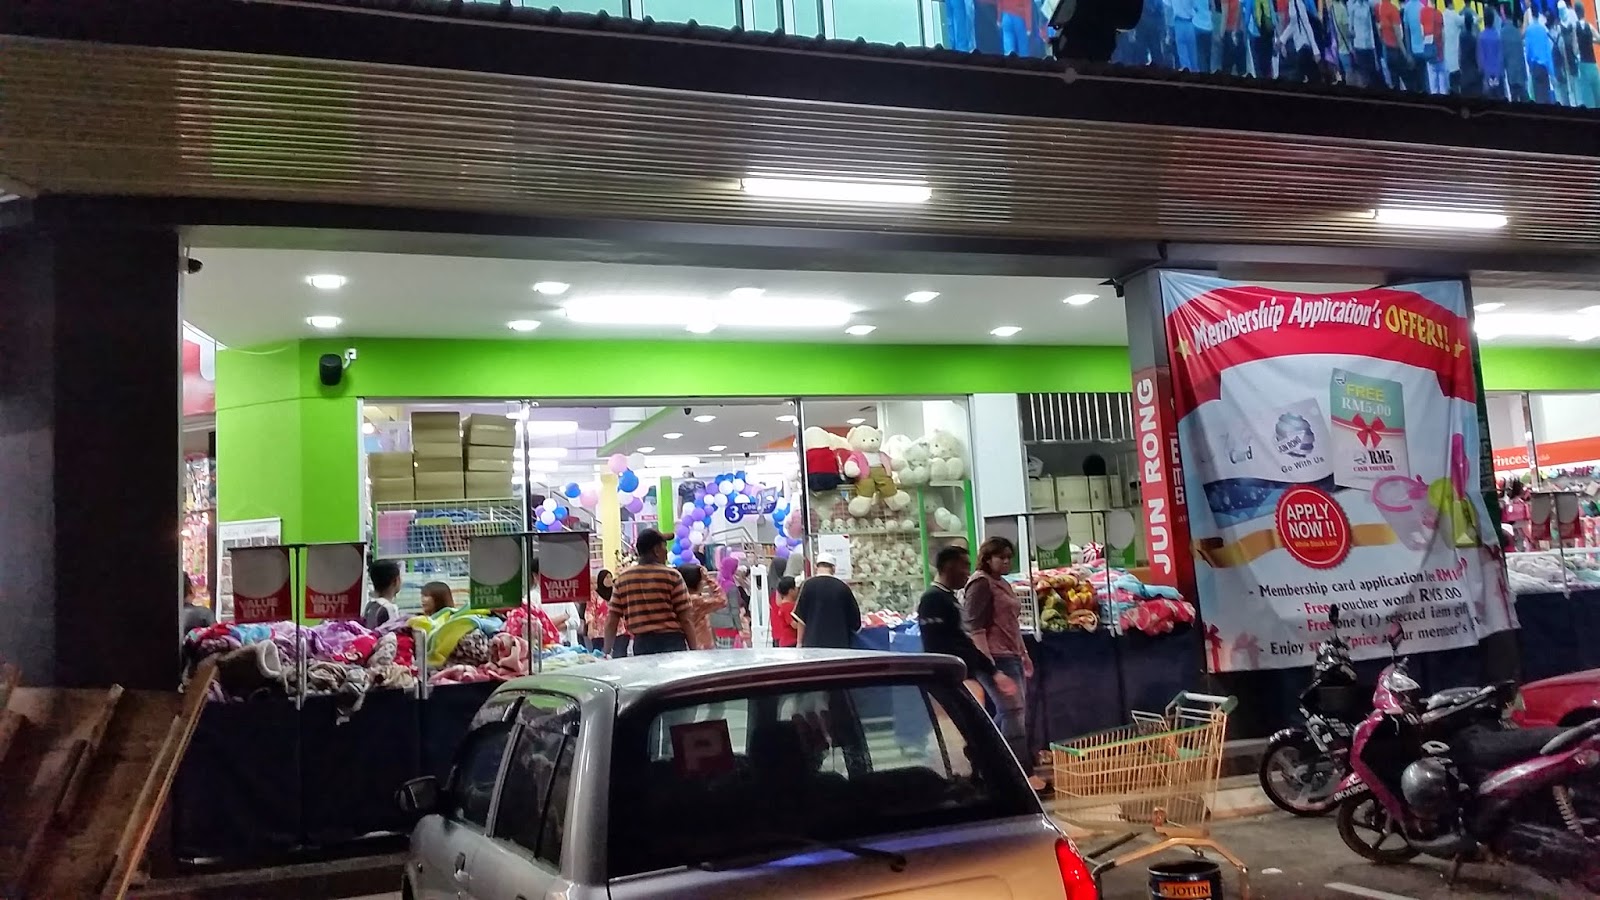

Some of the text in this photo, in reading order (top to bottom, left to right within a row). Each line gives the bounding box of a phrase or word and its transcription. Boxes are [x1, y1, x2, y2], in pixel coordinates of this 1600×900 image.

[1192, 296, 1451, 355] Membership Application's OFFER!!
[1346, 383, 1385, 403] FREE
[1342, 396, 1392, 417] RM5.00
[1229, 445, 1253, 465] Cd
[1368, 449, 1394, 465] RM5
[1281, 456, 1325, 474] Go With Us
[1369, 464, 1396, 472] VOUCHER
[1136, 378, 1172, 575] JUN RONG
[728, 502, 773, 521] 3 Couer
[1287, 502, 1329, 521] APPLY
[1288, 521, 1323, 539] NOW
[474, 585, 500, 595] HOT
[544, 579, 580, 591] VALUE
[1258, 581, 1328, 598] Membership
[1332, 579, 1356, 592] card
[1360, 570, 1424, 591] application
[239, 597, 278, 609] VALUE
[309, 594, 349, 605] VALUE
[474, 594, 504, 604] ITEM
[1304, 602, 1330, 614] Free
[1336, 597, 1378, 611] voucher
[1307, 619, 1332, 632] Free
[1336, 617, 1356, 629] one
[1361, 612, 1381, 629] (1)
[1430, 606, 1451, 618] iem
[1270, 639, 1305, 656] Enjoy
[1351, 633, 1378, 650] price
[1173, 885, 1209, 896] JOTUN
